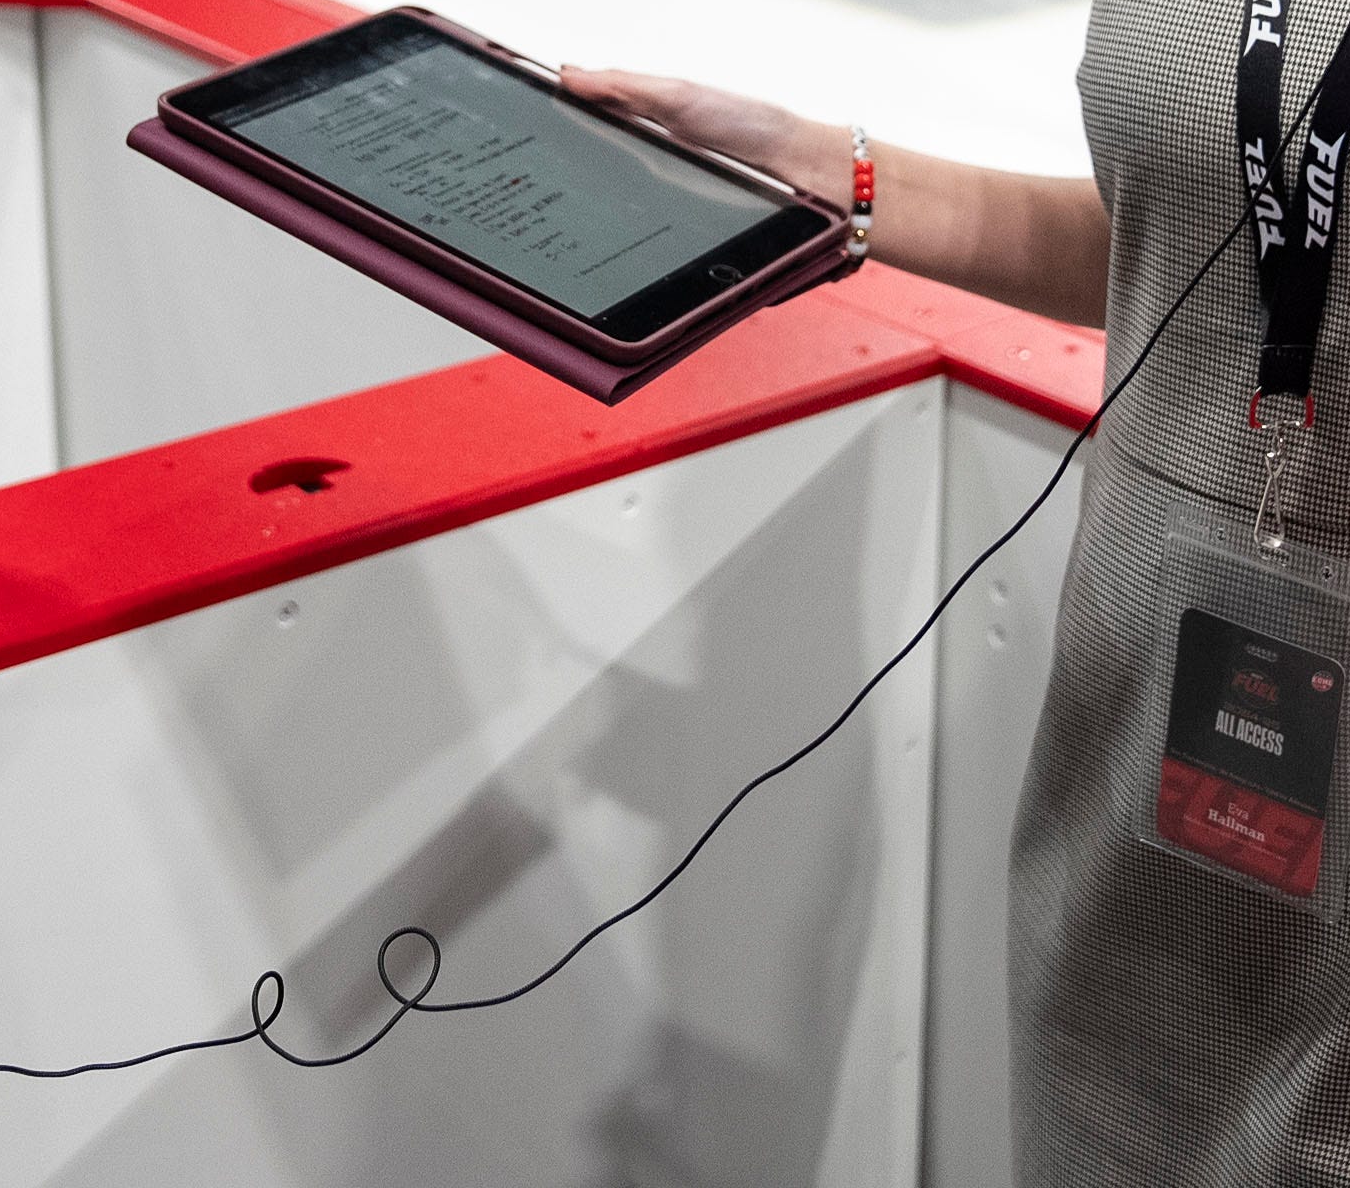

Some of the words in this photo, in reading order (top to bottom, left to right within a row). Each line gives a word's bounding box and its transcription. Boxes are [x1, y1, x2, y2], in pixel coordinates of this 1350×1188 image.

[1245, 137, 1286, 261] FUEL
[1305, 130, 1346, 249] FUEL
[1215, 709, 1235, 737] ALL
[1236, 718, 1285, 756] ACCESS
[1207, 808, 1266, 842] Hallman
[1227, 802, 1249, 821] Eva
